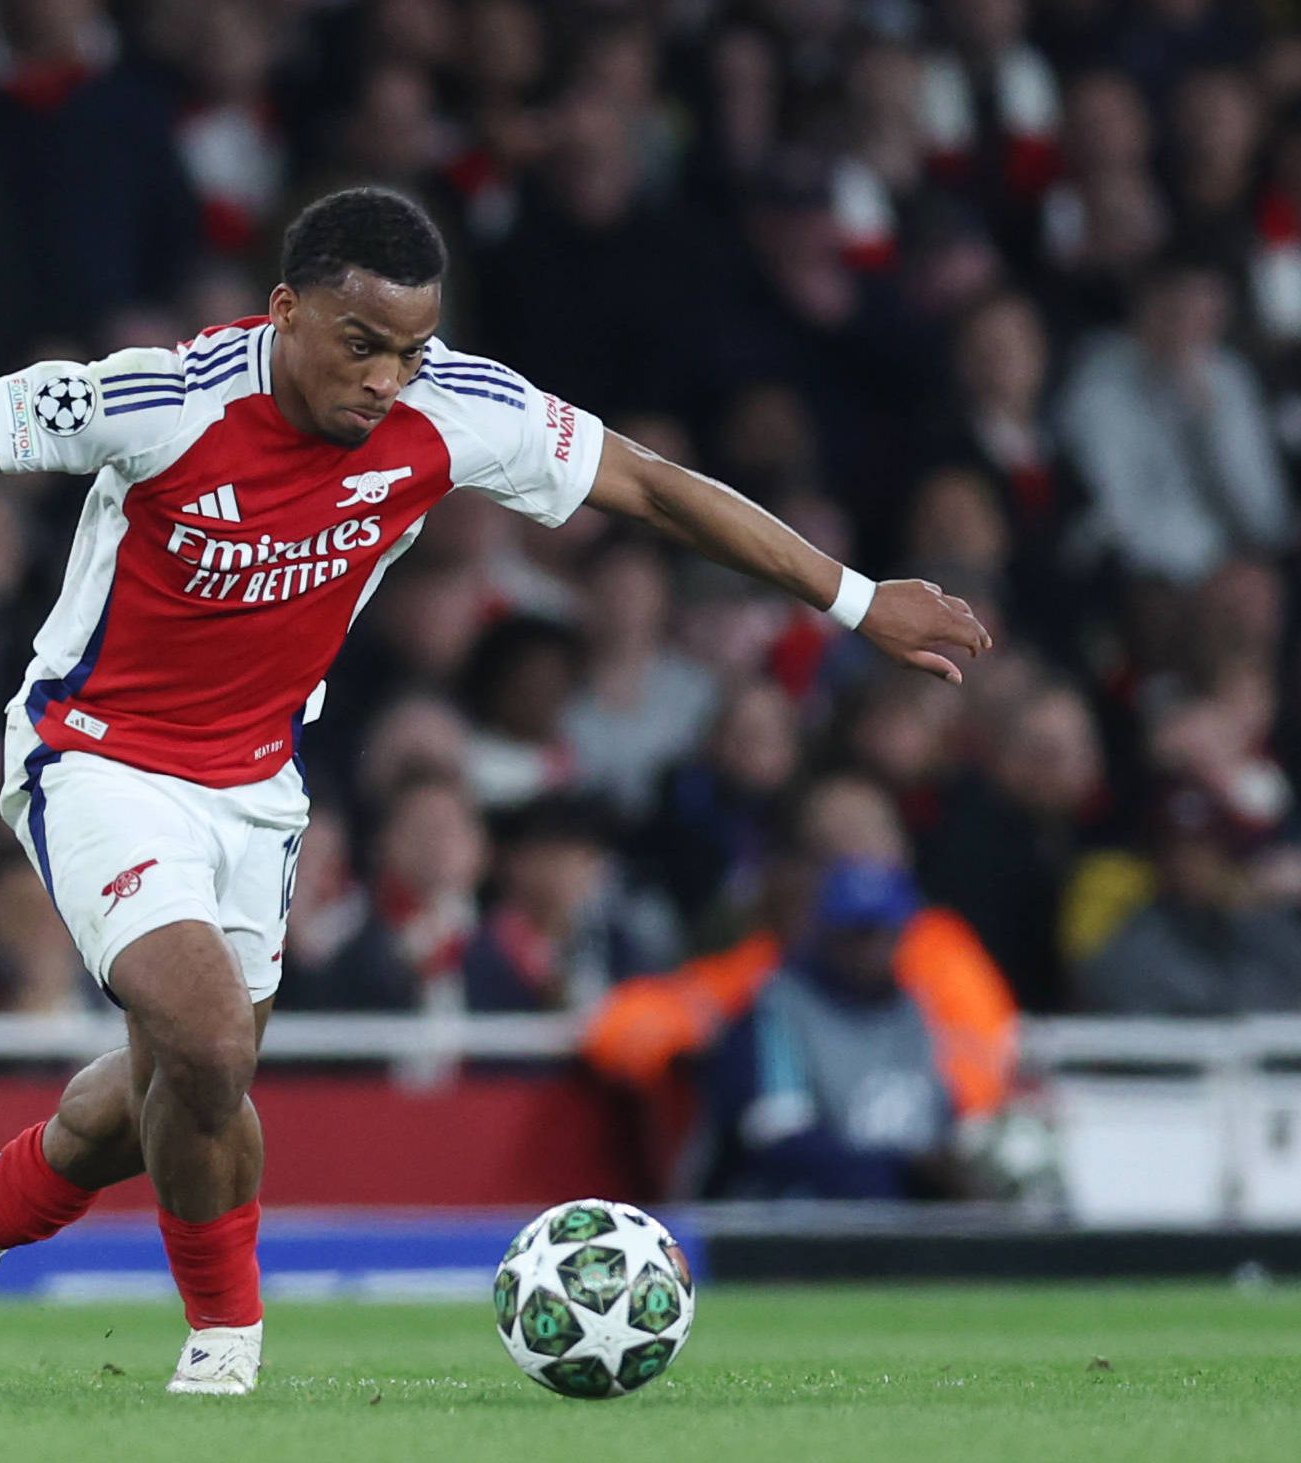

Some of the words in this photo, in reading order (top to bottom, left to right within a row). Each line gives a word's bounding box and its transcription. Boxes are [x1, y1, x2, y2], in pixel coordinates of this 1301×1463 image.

[11, 378, 31, 458] FOUNDATION
[554, 403, 575, 462] RWAN
[166, 515, 382, 573] Emirates
[183, 568, 241, 600] FLY
